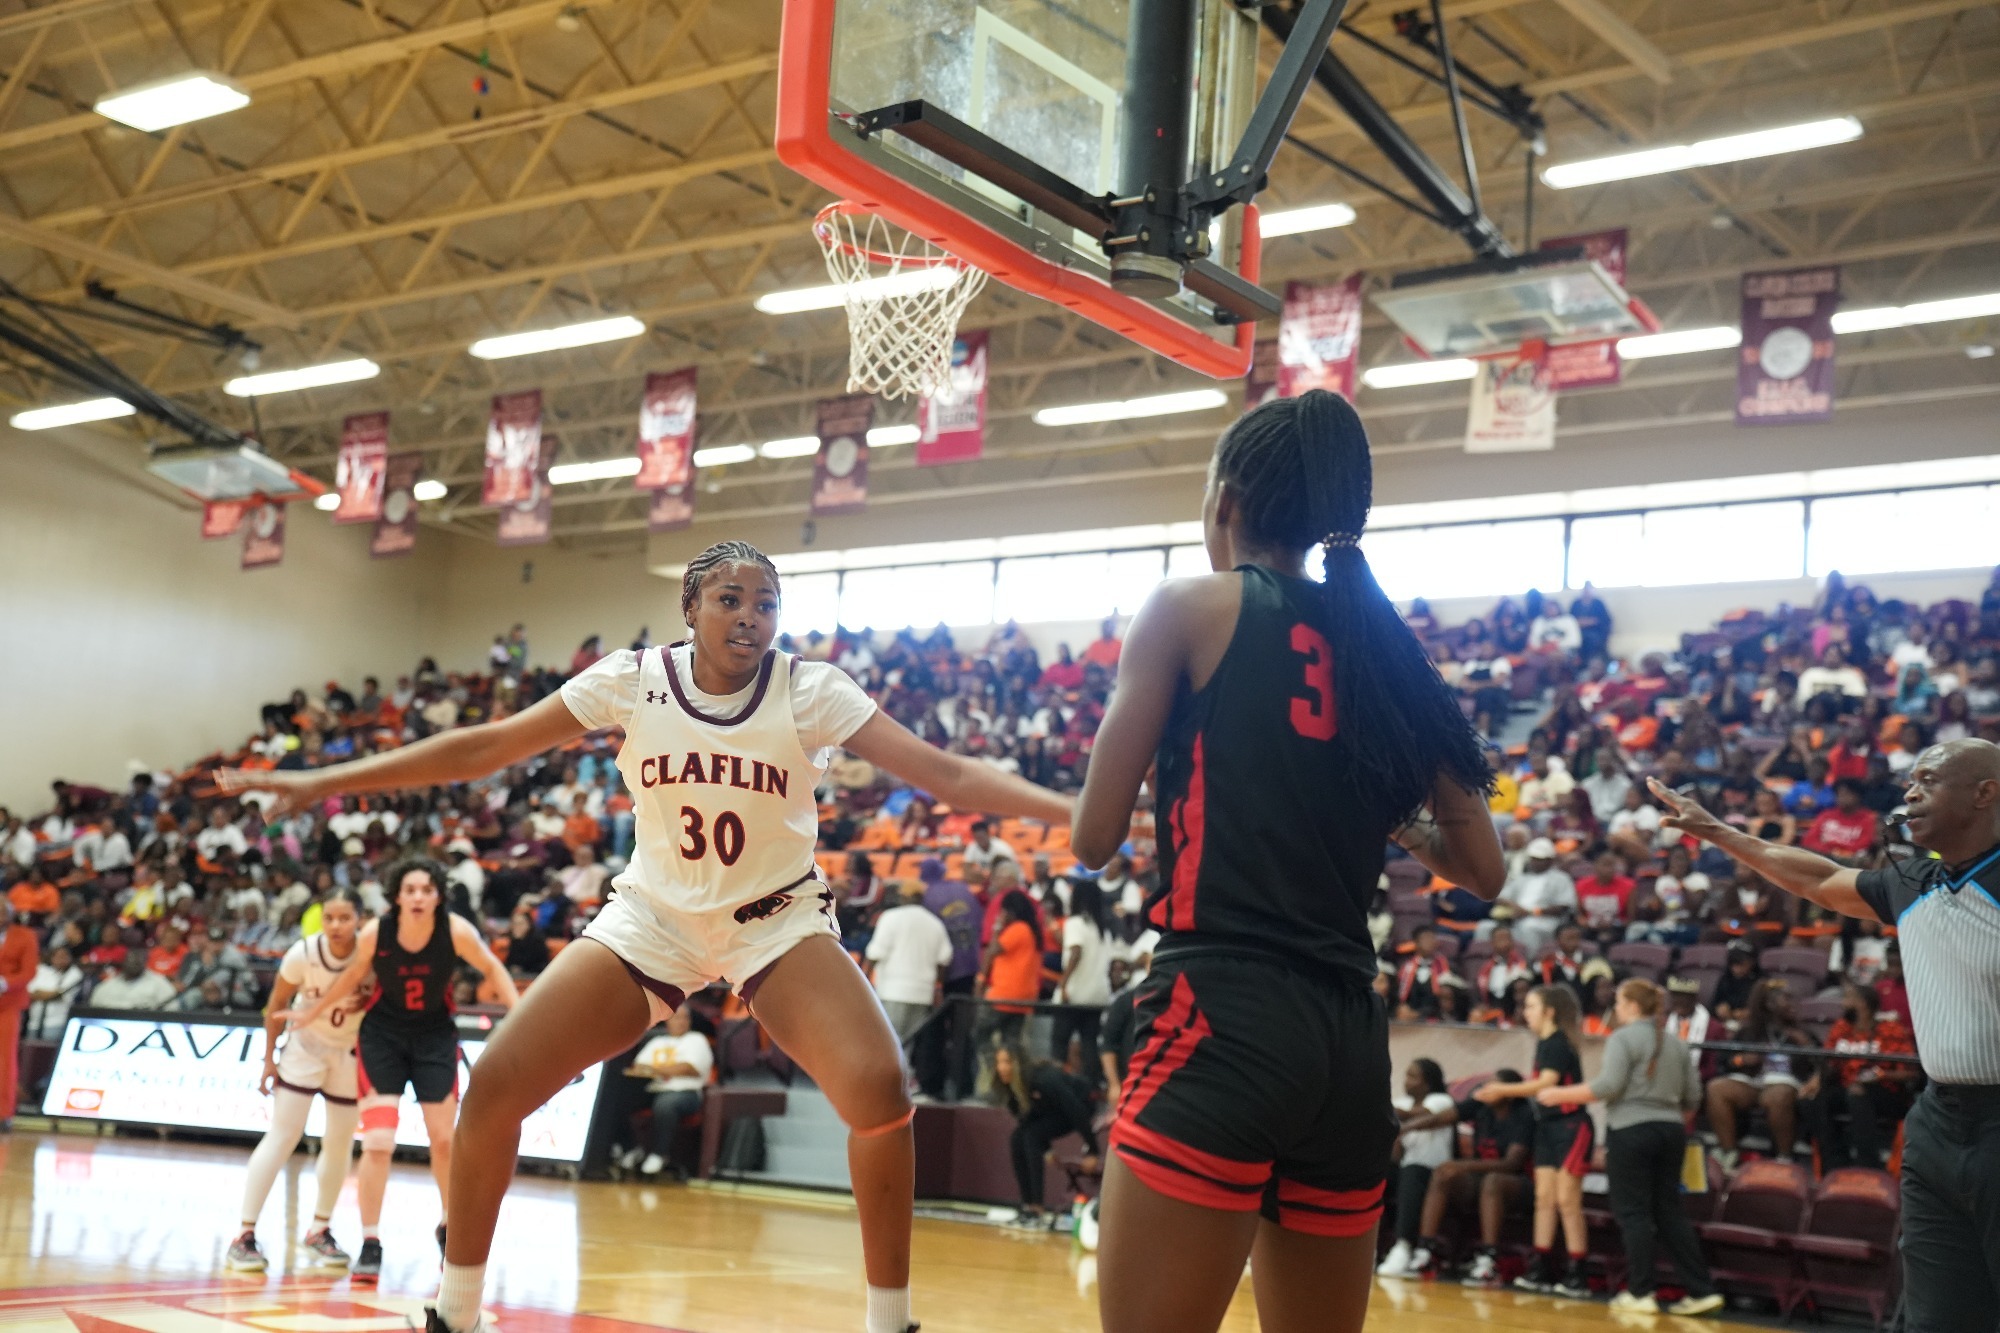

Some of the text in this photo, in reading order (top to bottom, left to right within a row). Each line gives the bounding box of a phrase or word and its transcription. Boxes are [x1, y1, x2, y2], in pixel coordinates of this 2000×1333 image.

[1289, 623, 1338, 741] 3
[641, 752, 789, 799] CLAFLIN
[680, 805, 745, 867] 30
[405, 979, 425, 1010] 2
[331, 1007, 345, 1028] 0
[73, 1025, 264, 1062] DAVI
